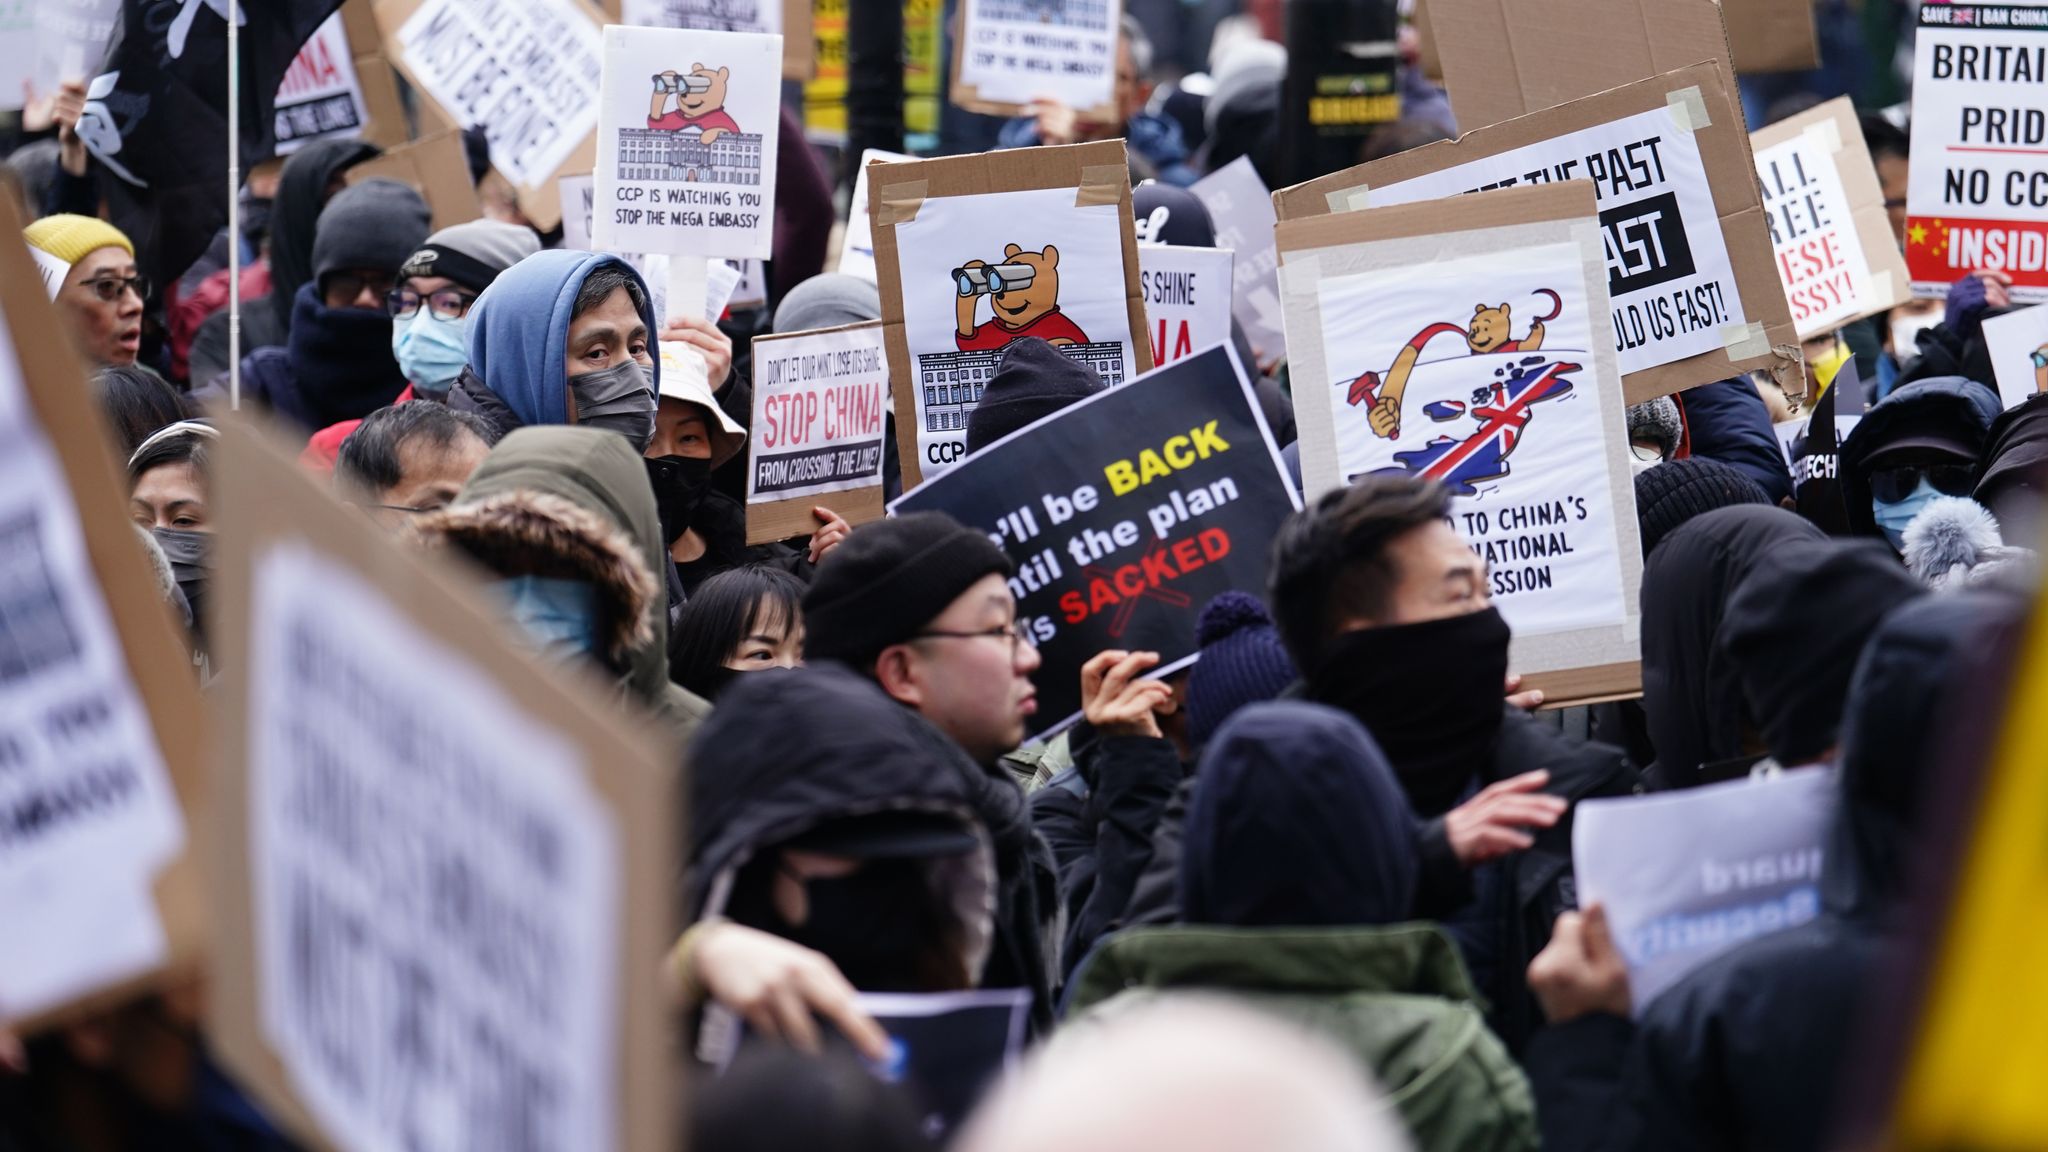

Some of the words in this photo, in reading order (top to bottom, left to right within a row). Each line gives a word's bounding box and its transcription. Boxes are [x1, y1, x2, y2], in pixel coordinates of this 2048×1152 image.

[1921, 6, 1952, 23] SAVE
[1982, 8, 2009, 25] BAN
[1933, 44, 2045, 83] BRITAI
[1961, 107, 2046, 145] PRID
[1585, 136, 1666, 201] PAST
[1945, 168, 1990, 205] NO
[2004, 171, 2048, 207] CC
[616, 187, 643, 201] CCP
[650, 189, 661, 203] IS
[667, 189, 731, 206] WATCHING
[738, 192, 761, 207] YOU
[1766, 190, 1831, 245] REE
[615, 209, 643, 225] STOP
[646, 210, 665, 225] THE
[671, 211, 704, 227] MEGA
[709, 212, 760, 228] EMBASSY
[1600, 210, 1668, 283] AST
[1779, 231, 1845, 286] ESE
[1948, 227, 2048, 273] INSID
[1154, 271, 1196, 306] SHINE
[1790, 270, 1857, 321] SSY!
[1612, 303, 1647, 353] OLD
[1644, 295, 1675, 342] US
[1672, 280, 1729, 334] FAST!
[768, 358, 787, 385] DON'T
[788, 356, 800, 382] LET
[801, 354, 816, 381] OUR
[816, 352, 832, 379] MINT
[834, 350, 851, 377] LOSE
[852, 348, 862, 374] ITS
[863, 346, 881, 373] SHINE
[763, 391, 818, 448] STOP
[824, 382, 881, 440] CHINA
[758, 459, 789, 487] FROM
[788, 452, 836, 483] CROSSING
[836, 449, 856, 476] THE
[855, 446, 880, 473] LINE!
[927, 441, 966, 465] CCP
[988, 505, 1040, 552] e'll
[1042, 484, 1100, 526] be
[1103, 419, 1231, 497] BACK
[1462, 512, 1489, 536] TO
[1499, 495, 1588, 531] CHINA'S
[1007, 548, 1063, 600] ntil
[1067, 519, 1139, 567] the
[1147, 476, 1240, 540] plan
[1469, 531, 1574, 565] NATIONAL
[1059, 527, 1232, 624] SACKED
[1486, 566, 1553, 598] SSION
